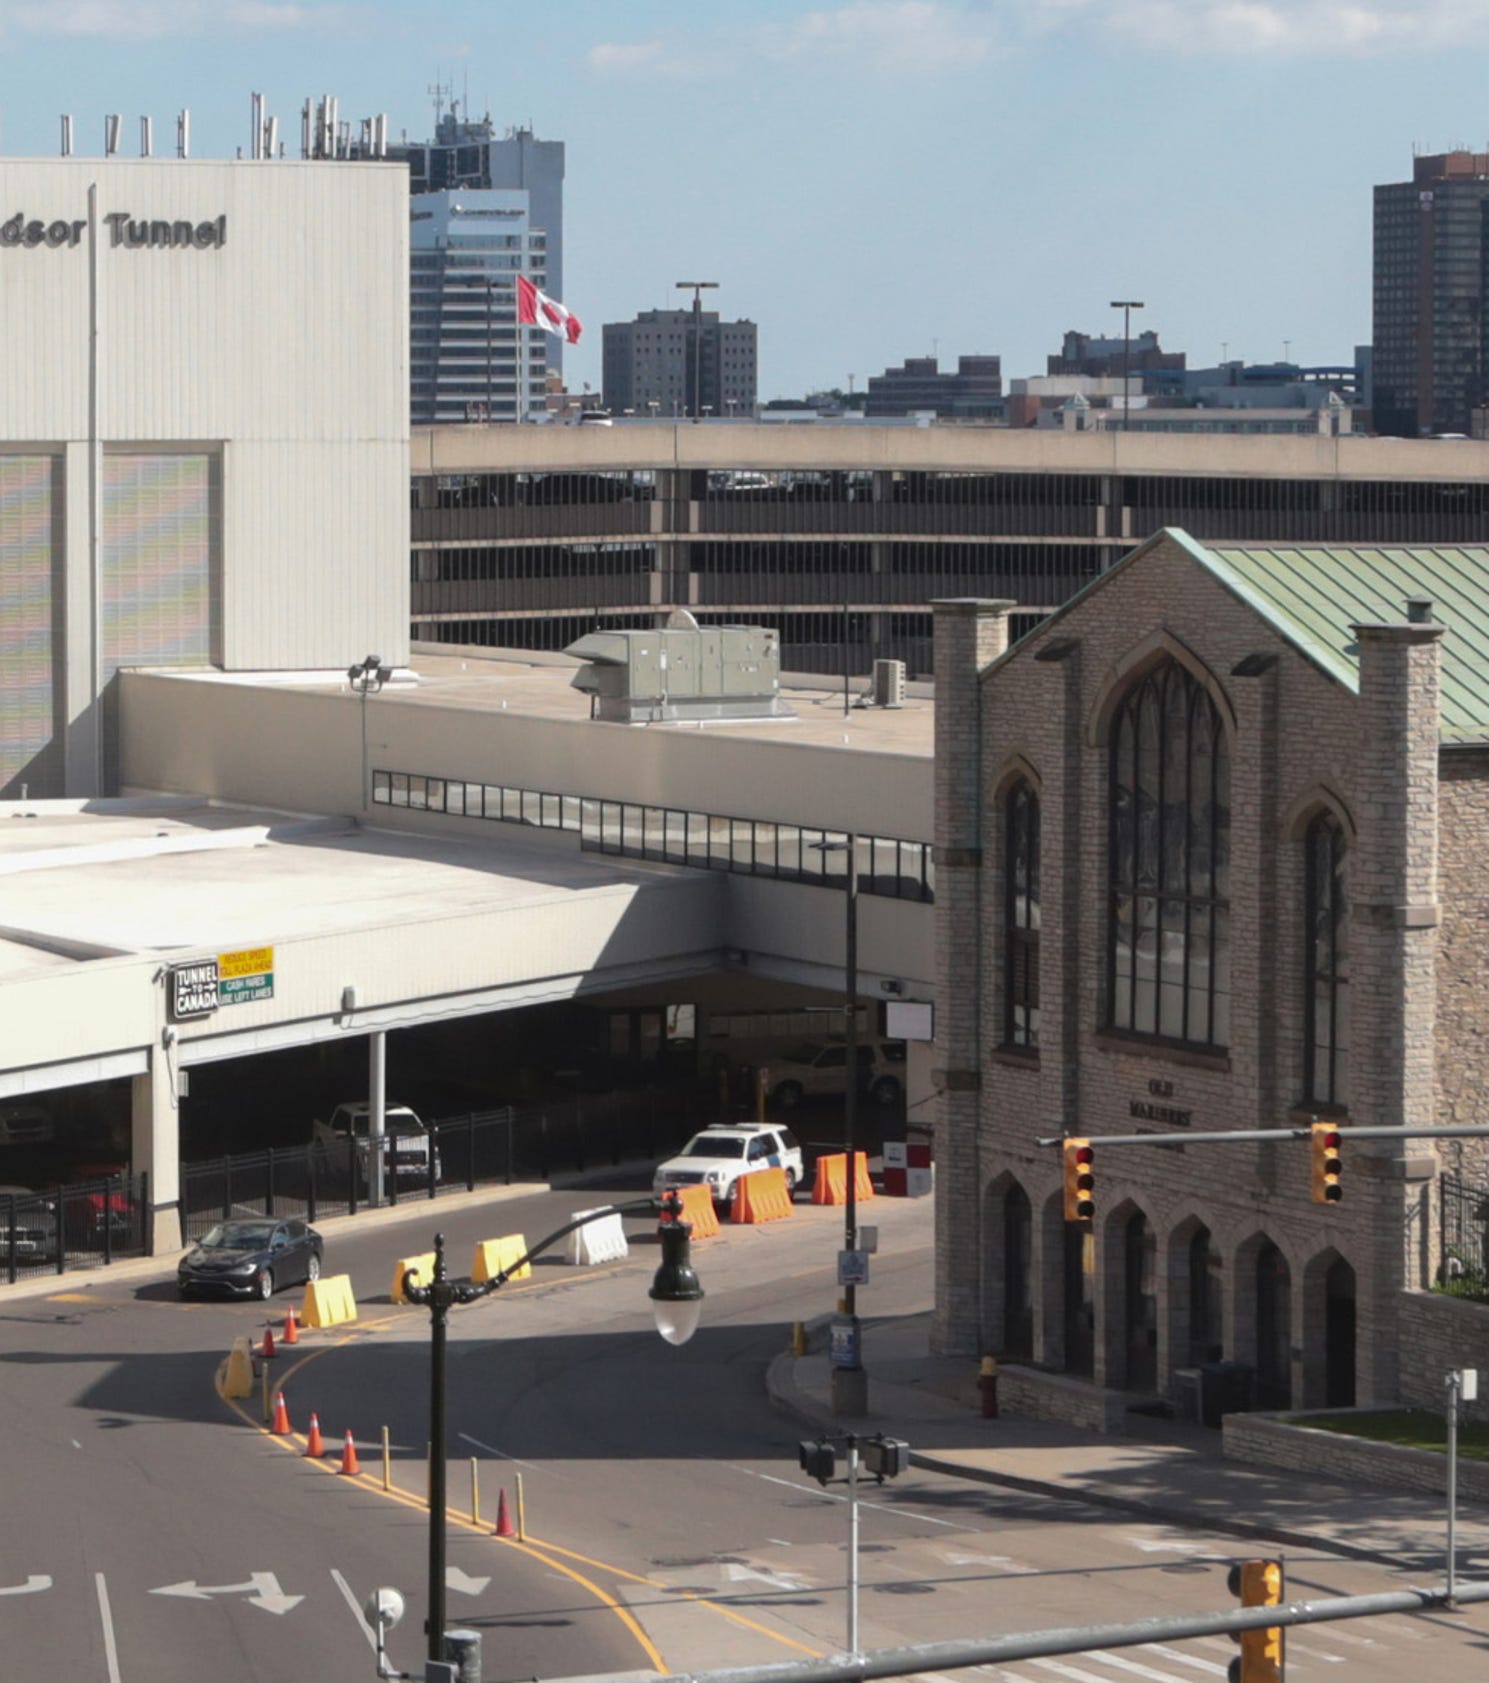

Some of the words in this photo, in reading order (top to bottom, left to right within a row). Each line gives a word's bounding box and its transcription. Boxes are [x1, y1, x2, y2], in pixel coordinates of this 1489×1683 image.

[105, 212, 227, 250] Tunnel
[177, 965, 217, 986] TUNNEL
[192, 984, 203, 992] TO
[226, 979, 244, 991] CASH
[177, 991, 218, 1013] CANADA
[234, 990, 250, 1002] LEFT
